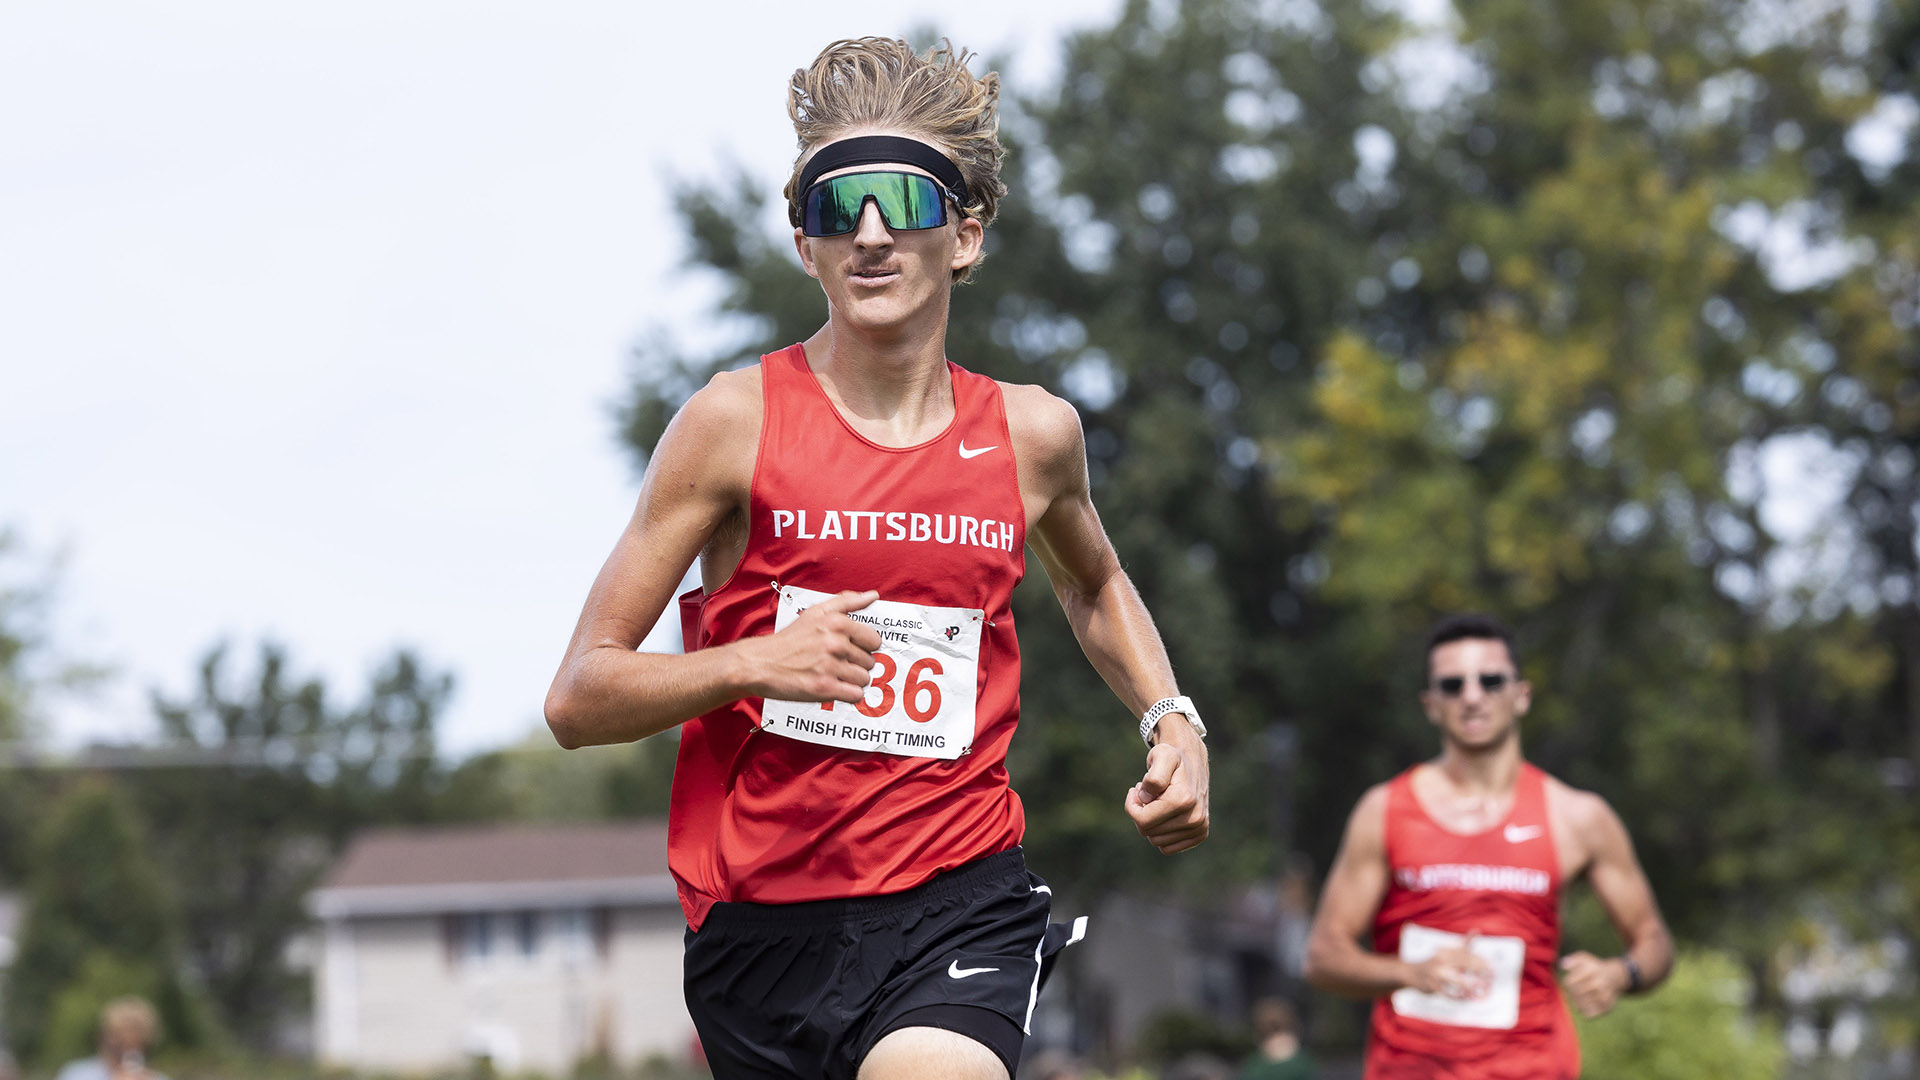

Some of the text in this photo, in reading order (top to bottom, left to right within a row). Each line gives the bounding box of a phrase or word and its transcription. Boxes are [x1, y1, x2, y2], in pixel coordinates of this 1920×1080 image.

[771, 509, 1015, 553] PLATTSBURGH
[875, 629, 909, 644] NVITE
[883, 618, 923, 630] CLASSIC
[820, 651, 944, 724] 36
[786, 715, 946, 749] FINISH RIGHT TIMING
